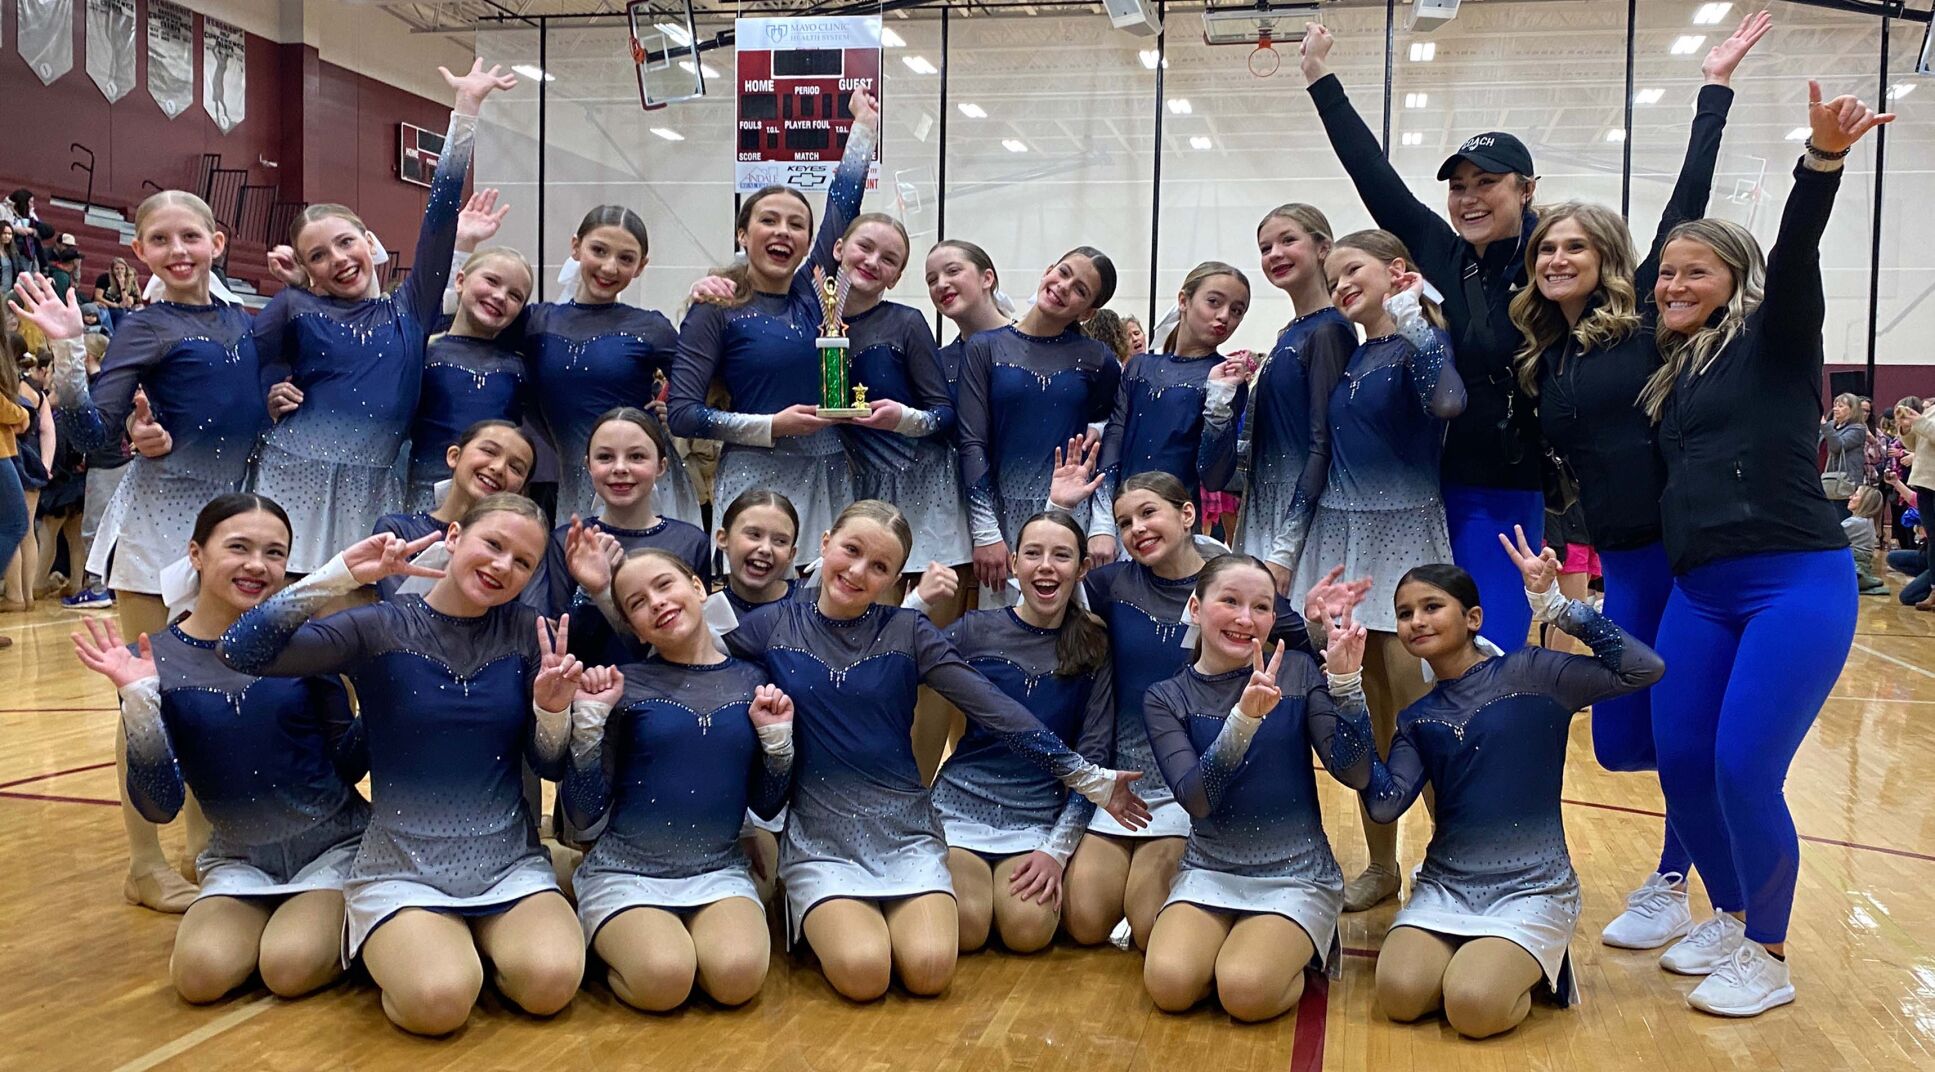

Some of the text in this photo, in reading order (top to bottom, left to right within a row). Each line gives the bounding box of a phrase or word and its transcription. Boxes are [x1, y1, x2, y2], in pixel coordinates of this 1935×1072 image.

[791, 23, 849, 32] MAYO CLINIC
[821, 33, 850, 41] SYSTEM
[744, 79, 775, 92] HOME
[838, 78, 873, 91] GUEST
[794, 85, 820, 95] PERIOD
[739, 120, 762, 130] FOULS
[784, 120, 831, 130] PLAYER FOUL
[738, 152, 762, 161] SCORE
[794, 152, 820, 161] MATCH
